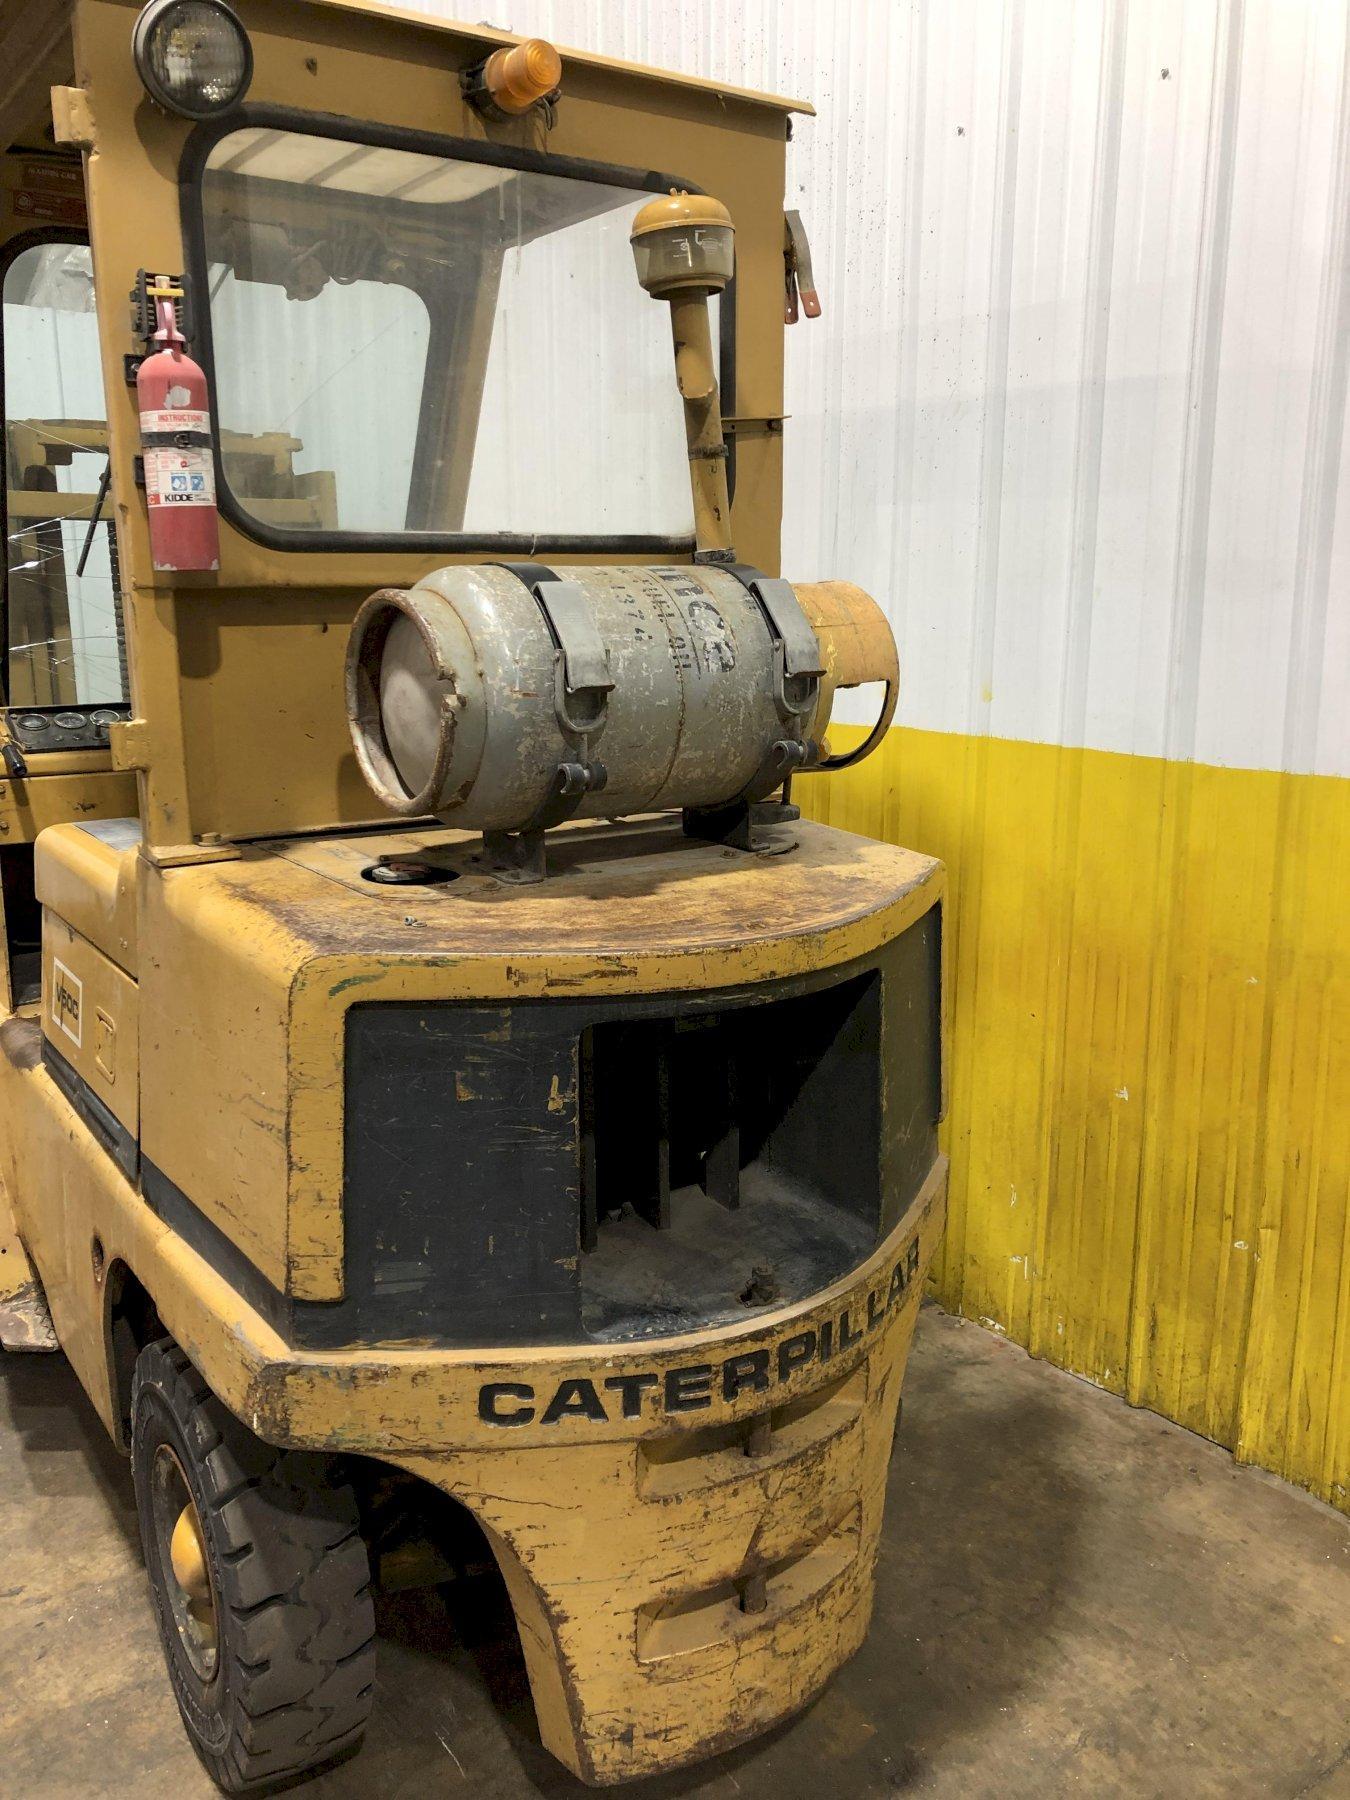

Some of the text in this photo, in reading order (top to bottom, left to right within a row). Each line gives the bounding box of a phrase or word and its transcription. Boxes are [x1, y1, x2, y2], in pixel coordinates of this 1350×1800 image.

[156, 414, 203, 422] INSTRUCTIONS
[164, 493, 193, 502] KIDDE
[478, 1236, 919, 1428] CATERPILLAR
